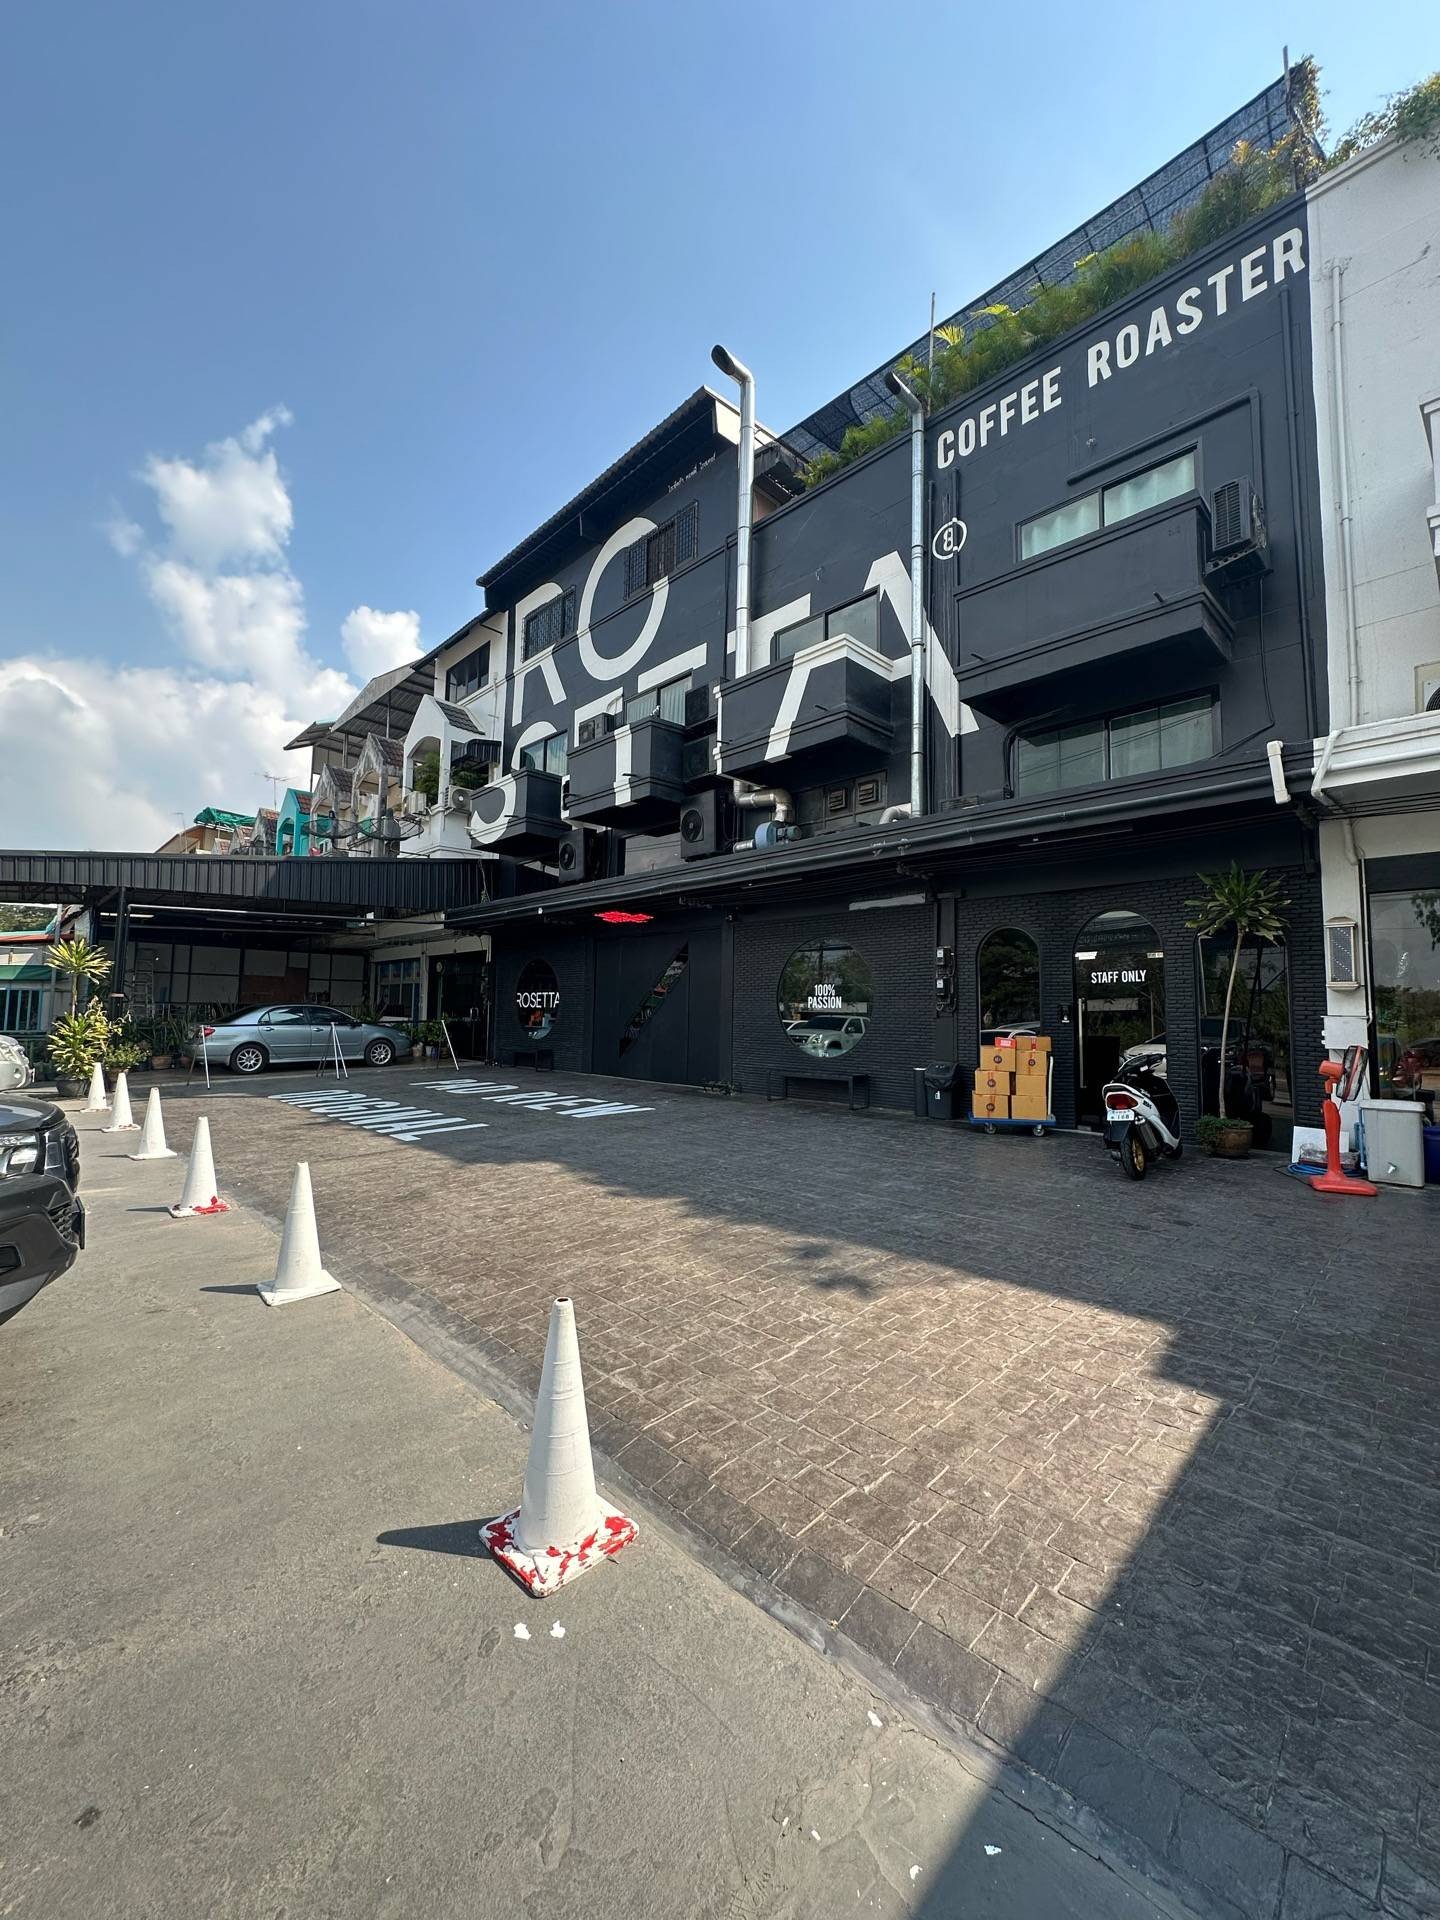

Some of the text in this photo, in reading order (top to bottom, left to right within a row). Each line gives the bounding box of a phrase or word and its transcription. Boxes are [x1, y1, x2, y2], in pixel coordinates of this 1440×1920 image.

[936, 226, 1307, 470] COFFEE ROASTER
[1090, 969, 1147, 984] STAFF ONLY
[814, 983, 836, 997] 100%
[516, 991, 560, 1008] ROSETTA
[807, 996, 842, 1009] PASSION
[481, 1090, 656, 1119] RIEW
[267, 1089, 490, 1142] ORIGINAL
